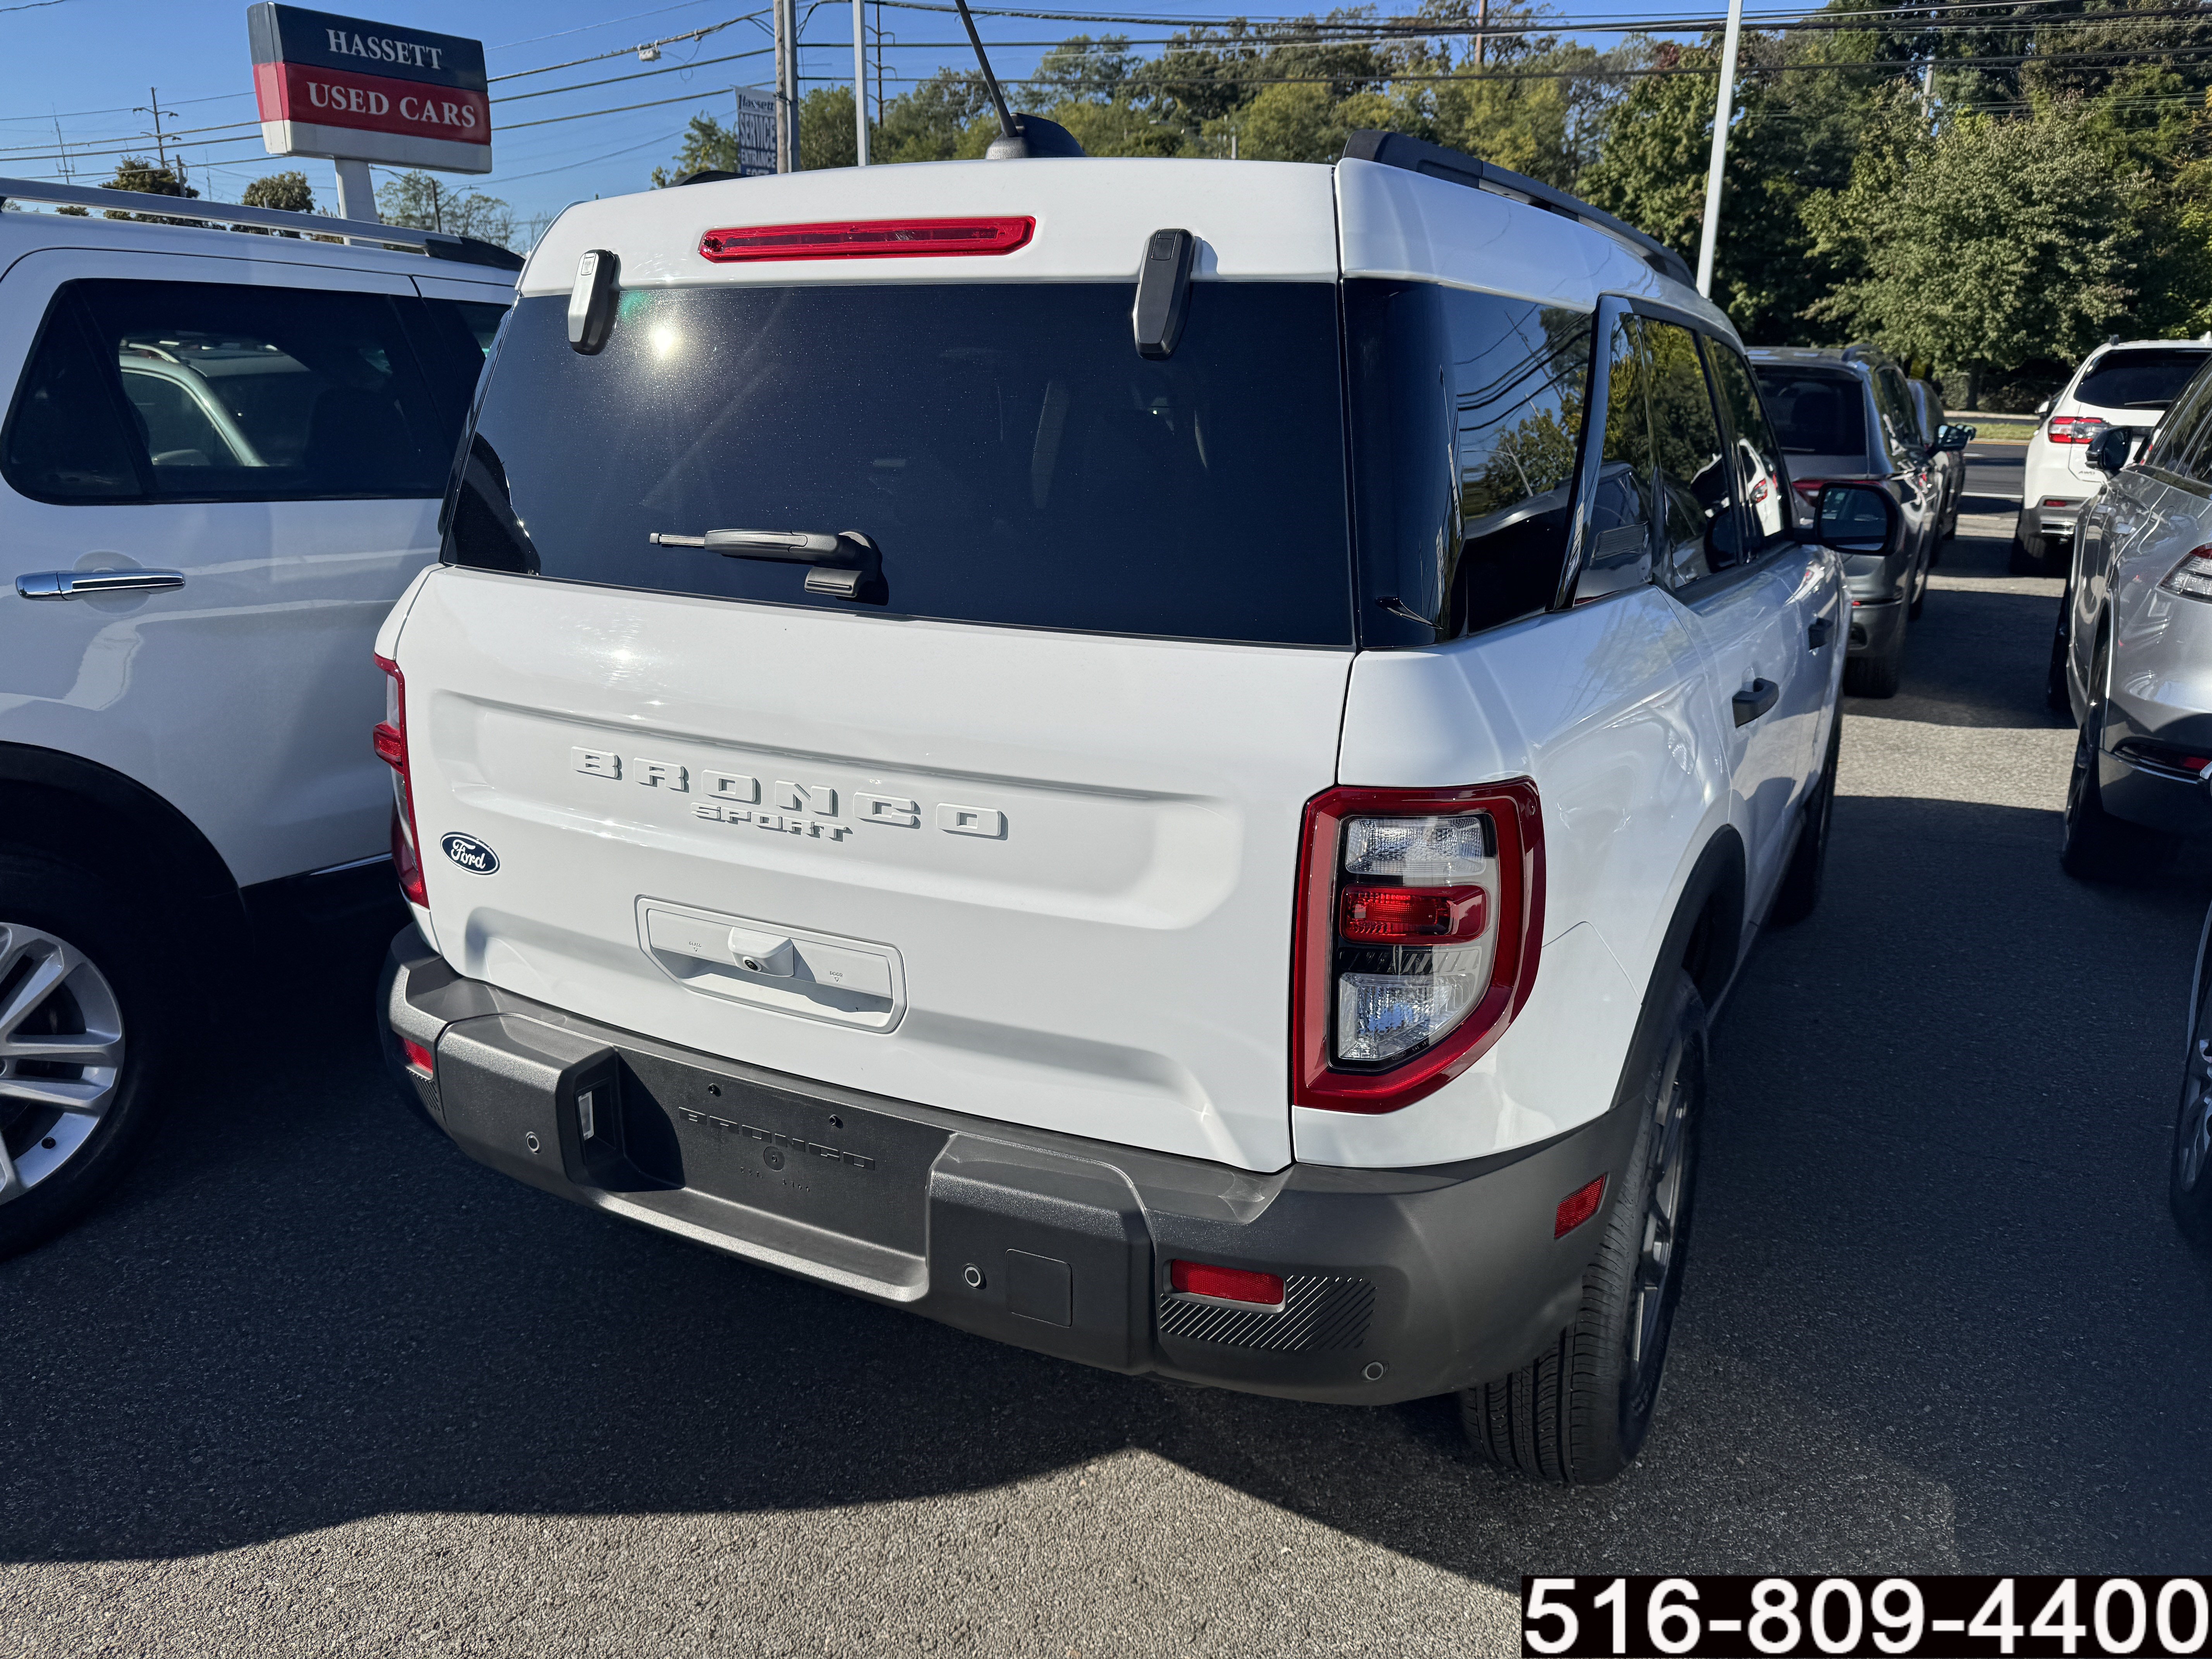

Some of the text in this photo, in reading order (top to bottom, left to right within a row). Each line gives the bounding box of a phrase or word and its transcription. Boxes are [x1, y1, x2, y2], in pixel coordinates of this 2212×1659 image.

[325, 28, 441, 70] HASSETT
[306, 81, 476, 128] USED CARS
[740, 113, 776, 150] SERVICE
[571, 745, 1008, 840] BRONCO
[690, 802, 853, 842] SPORT
[451, 839, 486, 869] Ford
[678, 1106, 876, 1171] BRONCO
